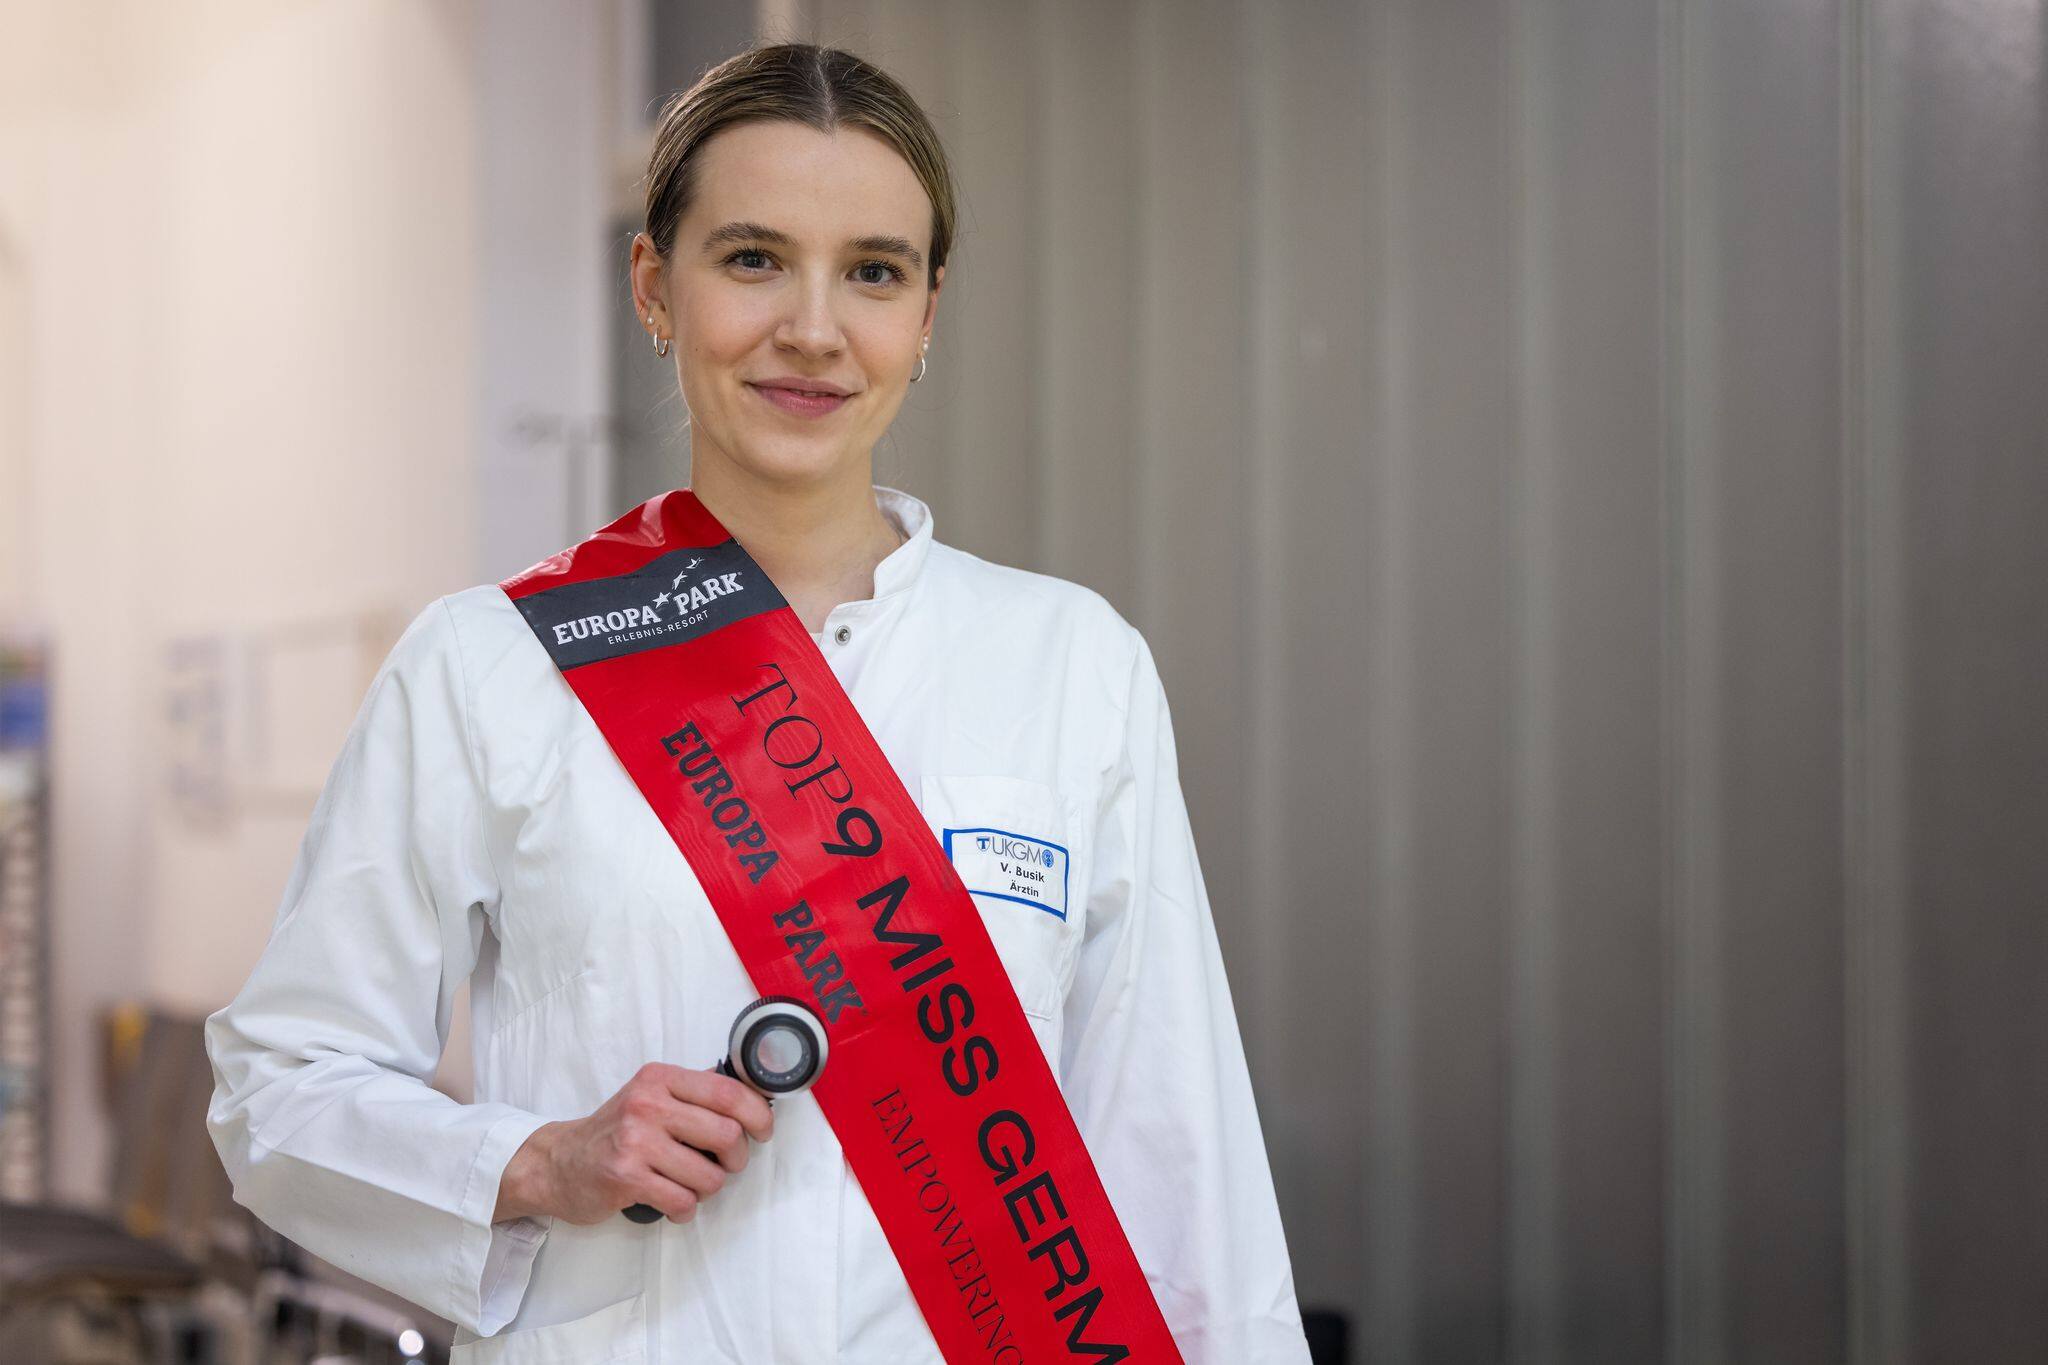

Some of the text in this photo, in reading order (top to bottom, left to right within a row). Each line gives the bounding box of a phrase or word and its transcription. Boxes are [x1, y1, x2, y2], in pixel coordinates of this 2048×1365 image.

[552, 572, 744, 645] EUROPA PARK
[607, 610, 710, 645] ERLEBNIS-RESORT
[660, 721, 867, 1025] EUROPA PARK
[1000, 862, 1045, 883] V. Busik
[1010, 879, 1039, 897] Ärztin
[856, 875, 999, 1097] MISS
[977, 1109, 1131, 1365] GERM
